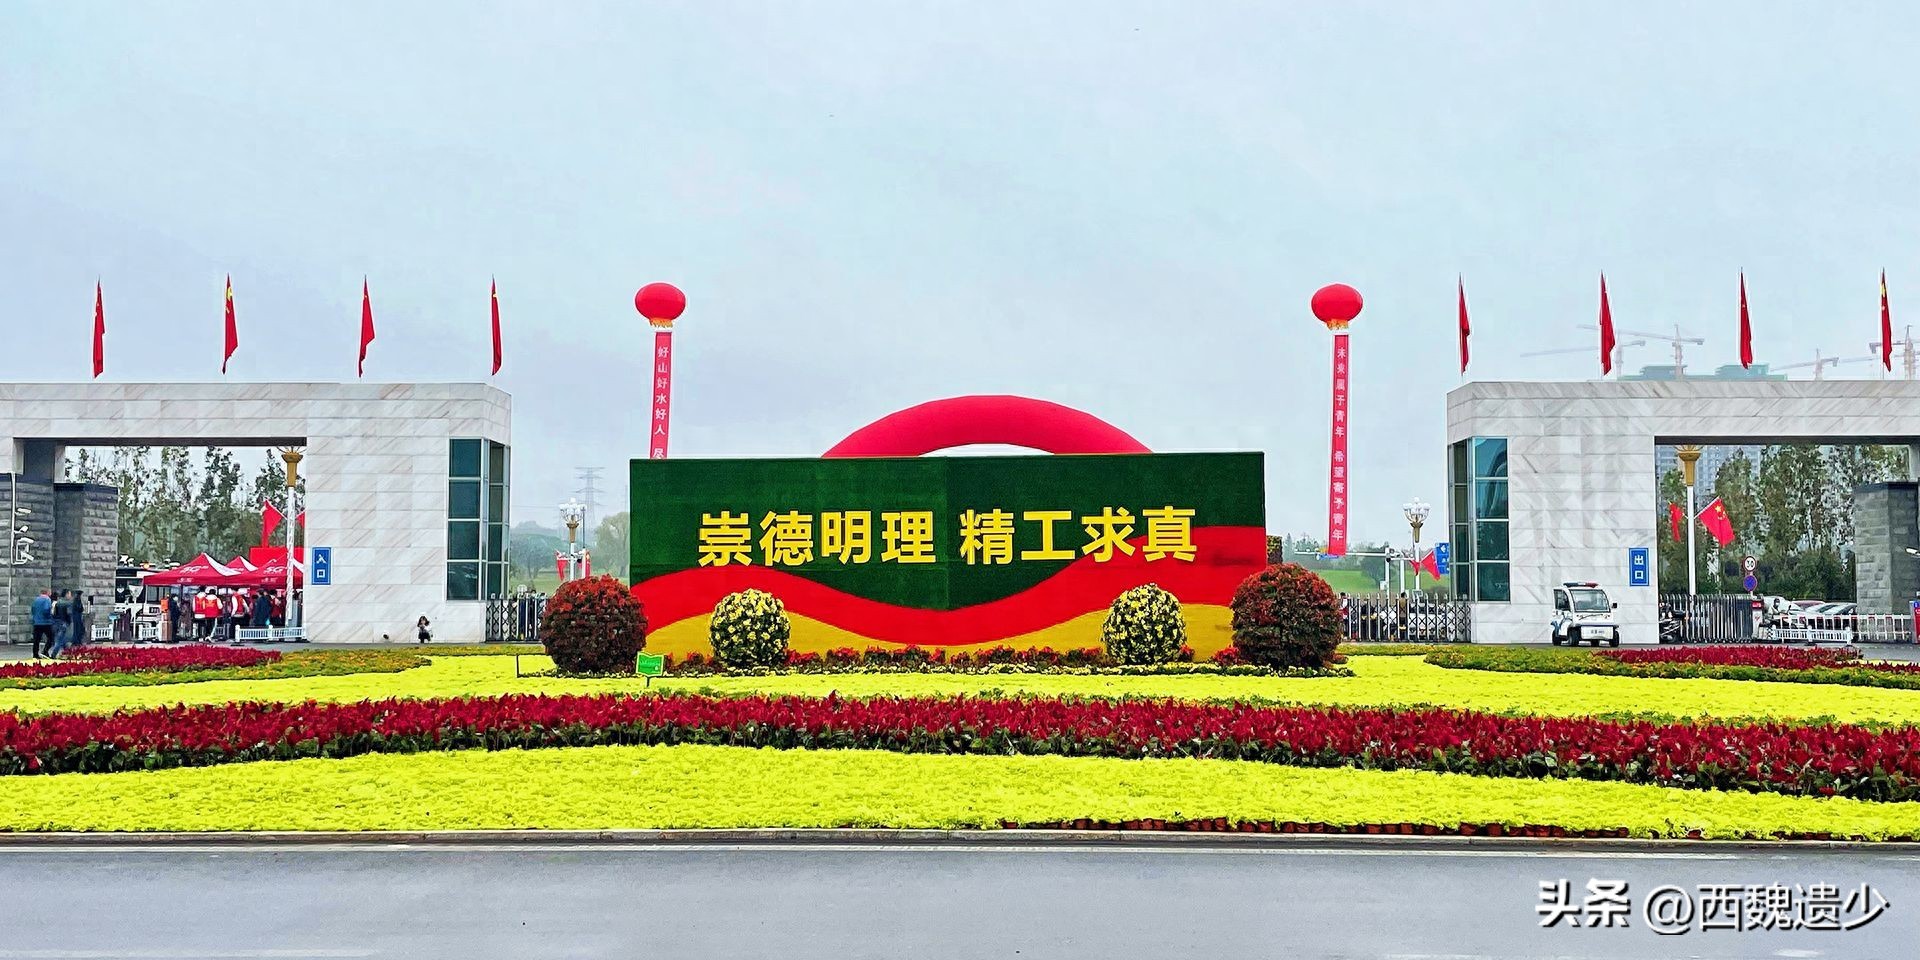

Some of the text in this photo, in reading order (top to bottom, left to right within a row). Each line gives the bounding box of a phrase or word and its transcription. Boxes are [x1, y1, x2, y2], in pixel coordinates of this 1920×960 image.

[654, 346, 670, 436] 好山好水好人
[1334, 347, 1347, 438] 未来属于青年
[316, 553, 327, 579] 入口
[698, 506, 1197, 567] 崇德明理 精工求真
[1634, 554, 1645, 580] 出口
